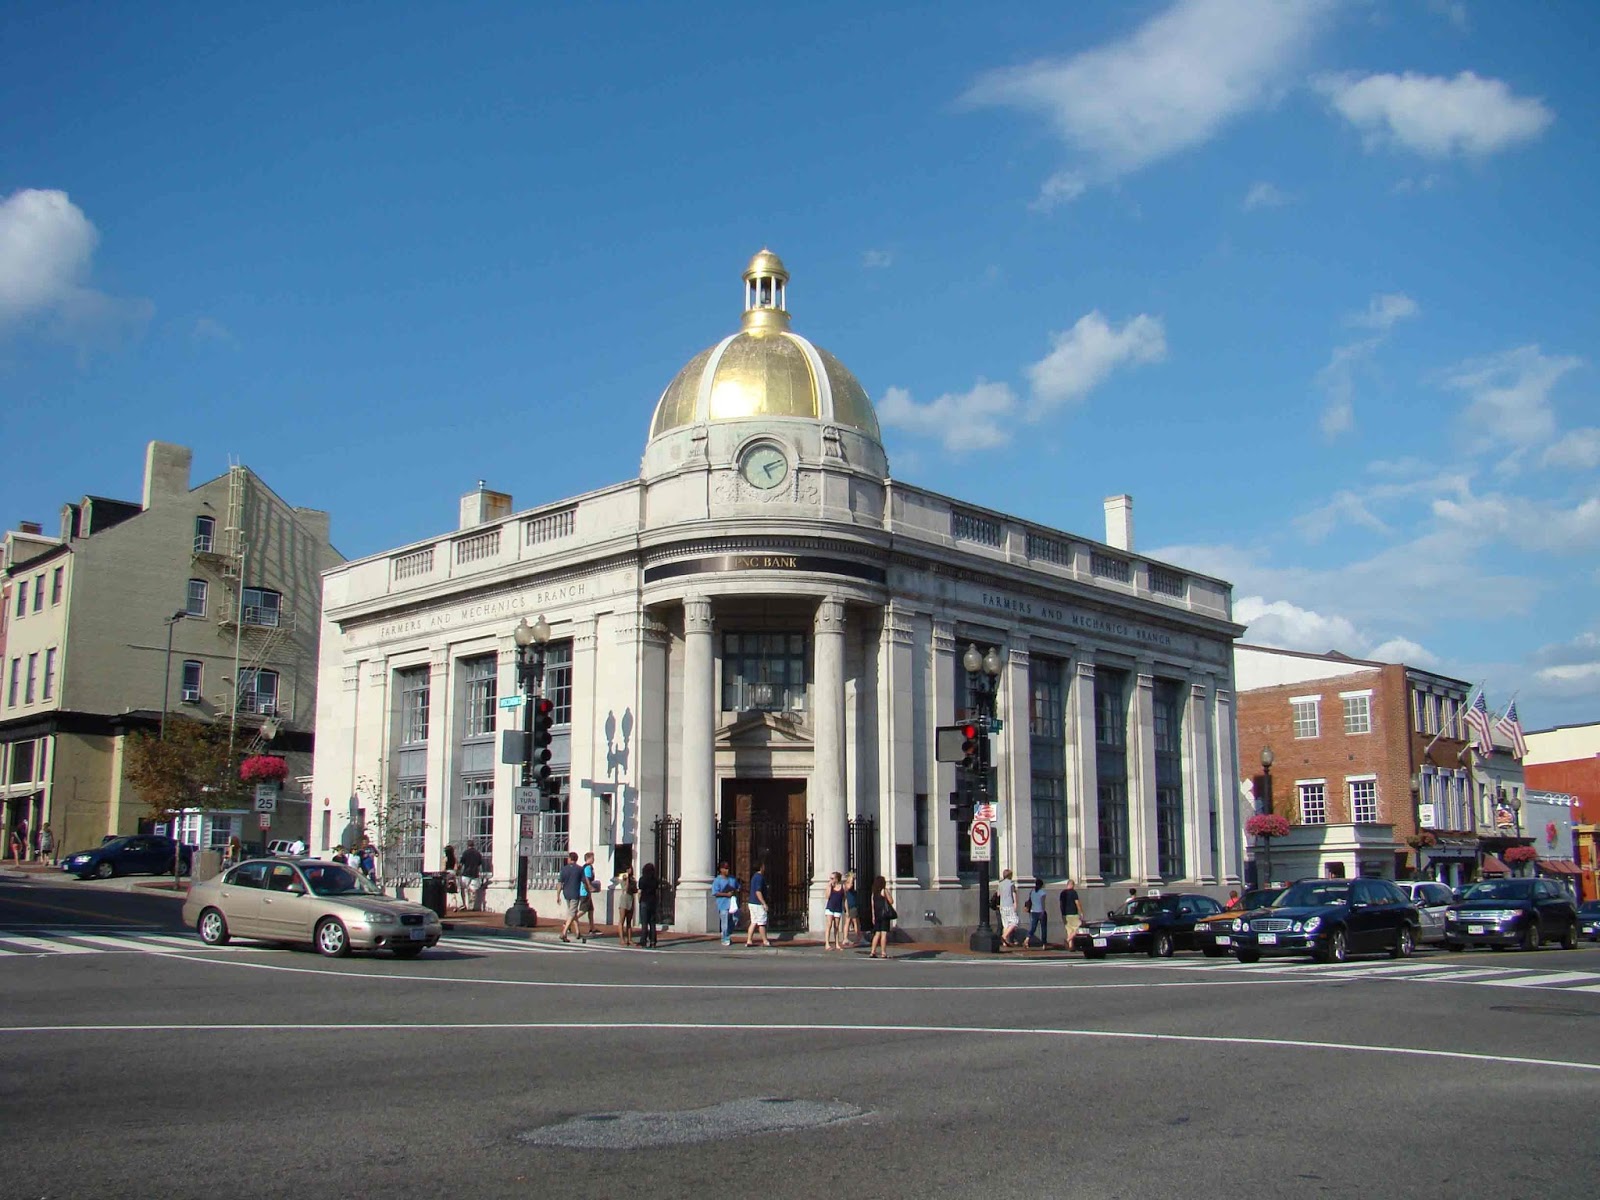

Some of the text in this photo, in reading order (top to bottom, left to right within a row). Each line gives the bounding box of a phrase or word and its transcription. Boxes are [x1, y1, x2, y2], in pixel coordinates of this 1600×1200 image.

[734, 557, 797, 568] PNC BANK
[381, 583, 585, 638] FARMERS AND MECHANICS BRANCH
[982, 593, 1171, 645] FARMERS AND MECHANICS BRANCH
[258, 798, 273, 809] 25
